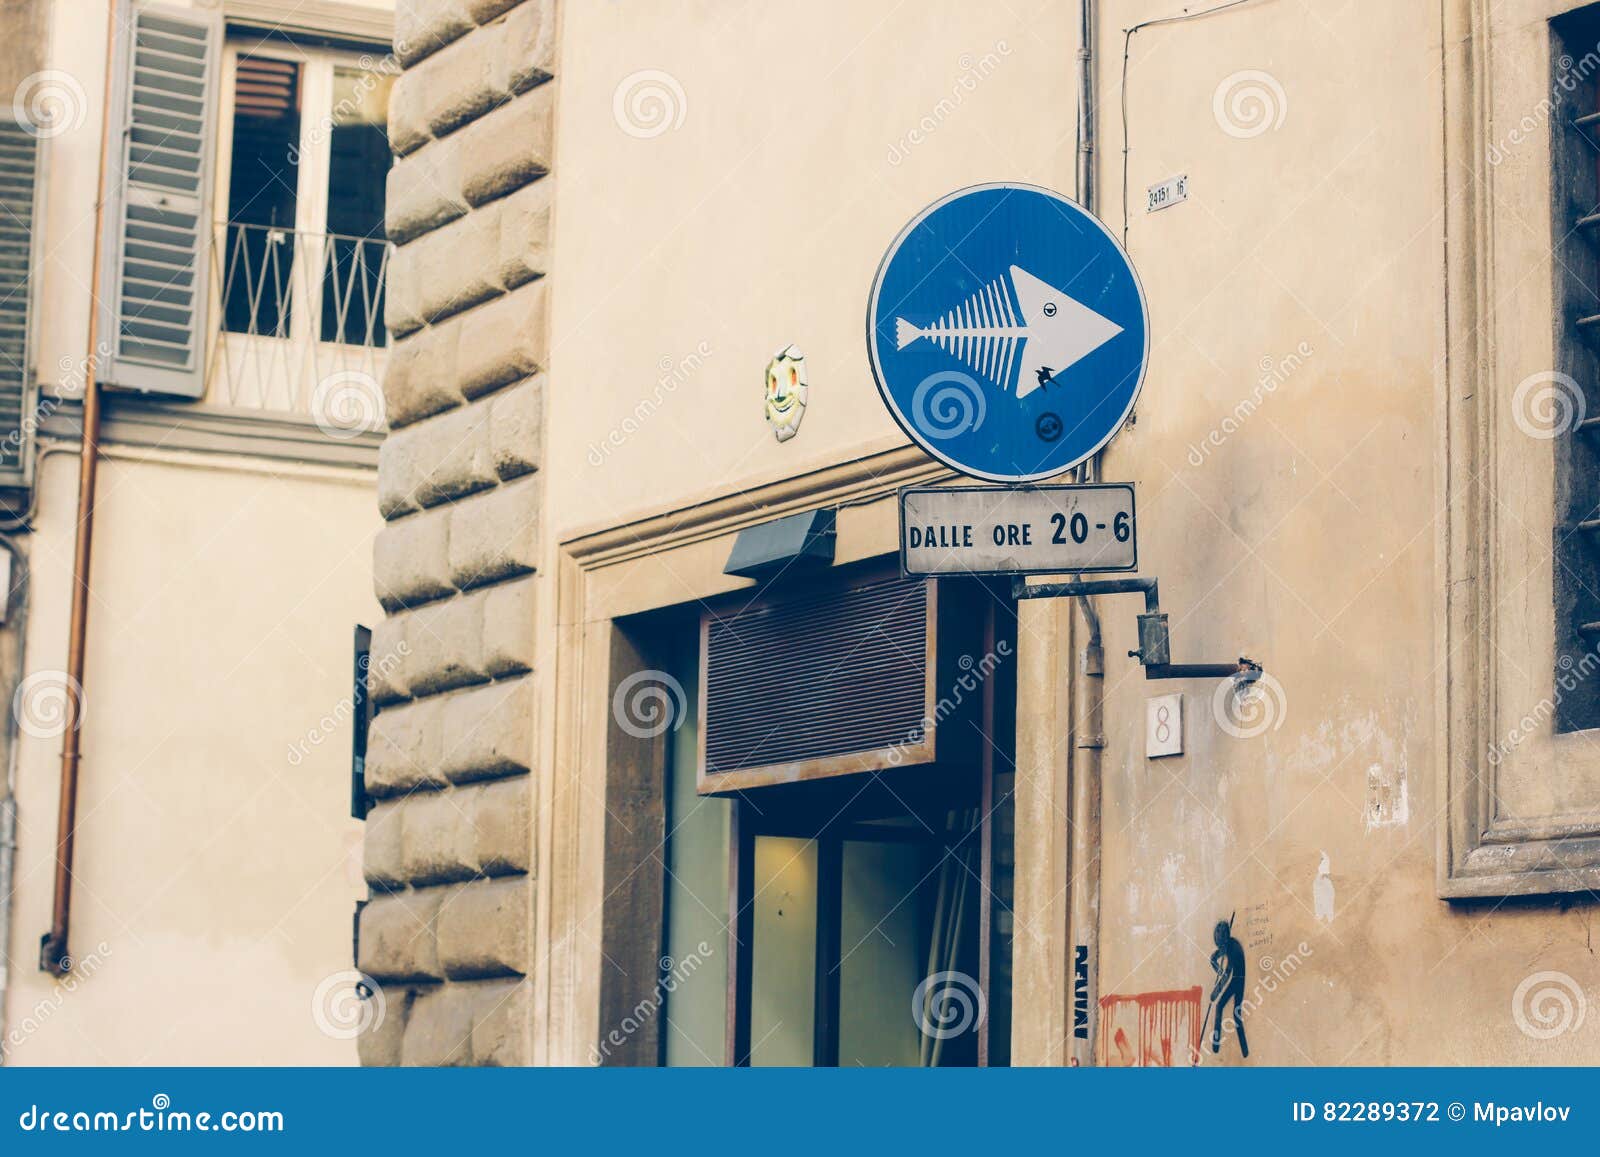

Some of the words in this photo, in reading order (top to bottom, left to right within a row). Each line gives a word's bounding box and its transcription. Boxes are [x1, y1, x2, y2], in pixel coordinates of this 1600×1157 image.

[910, 525, 974, 549] DALLE
[992, 523, 1033, 546] ORE
[1156, 705, 1170, 743] 8
